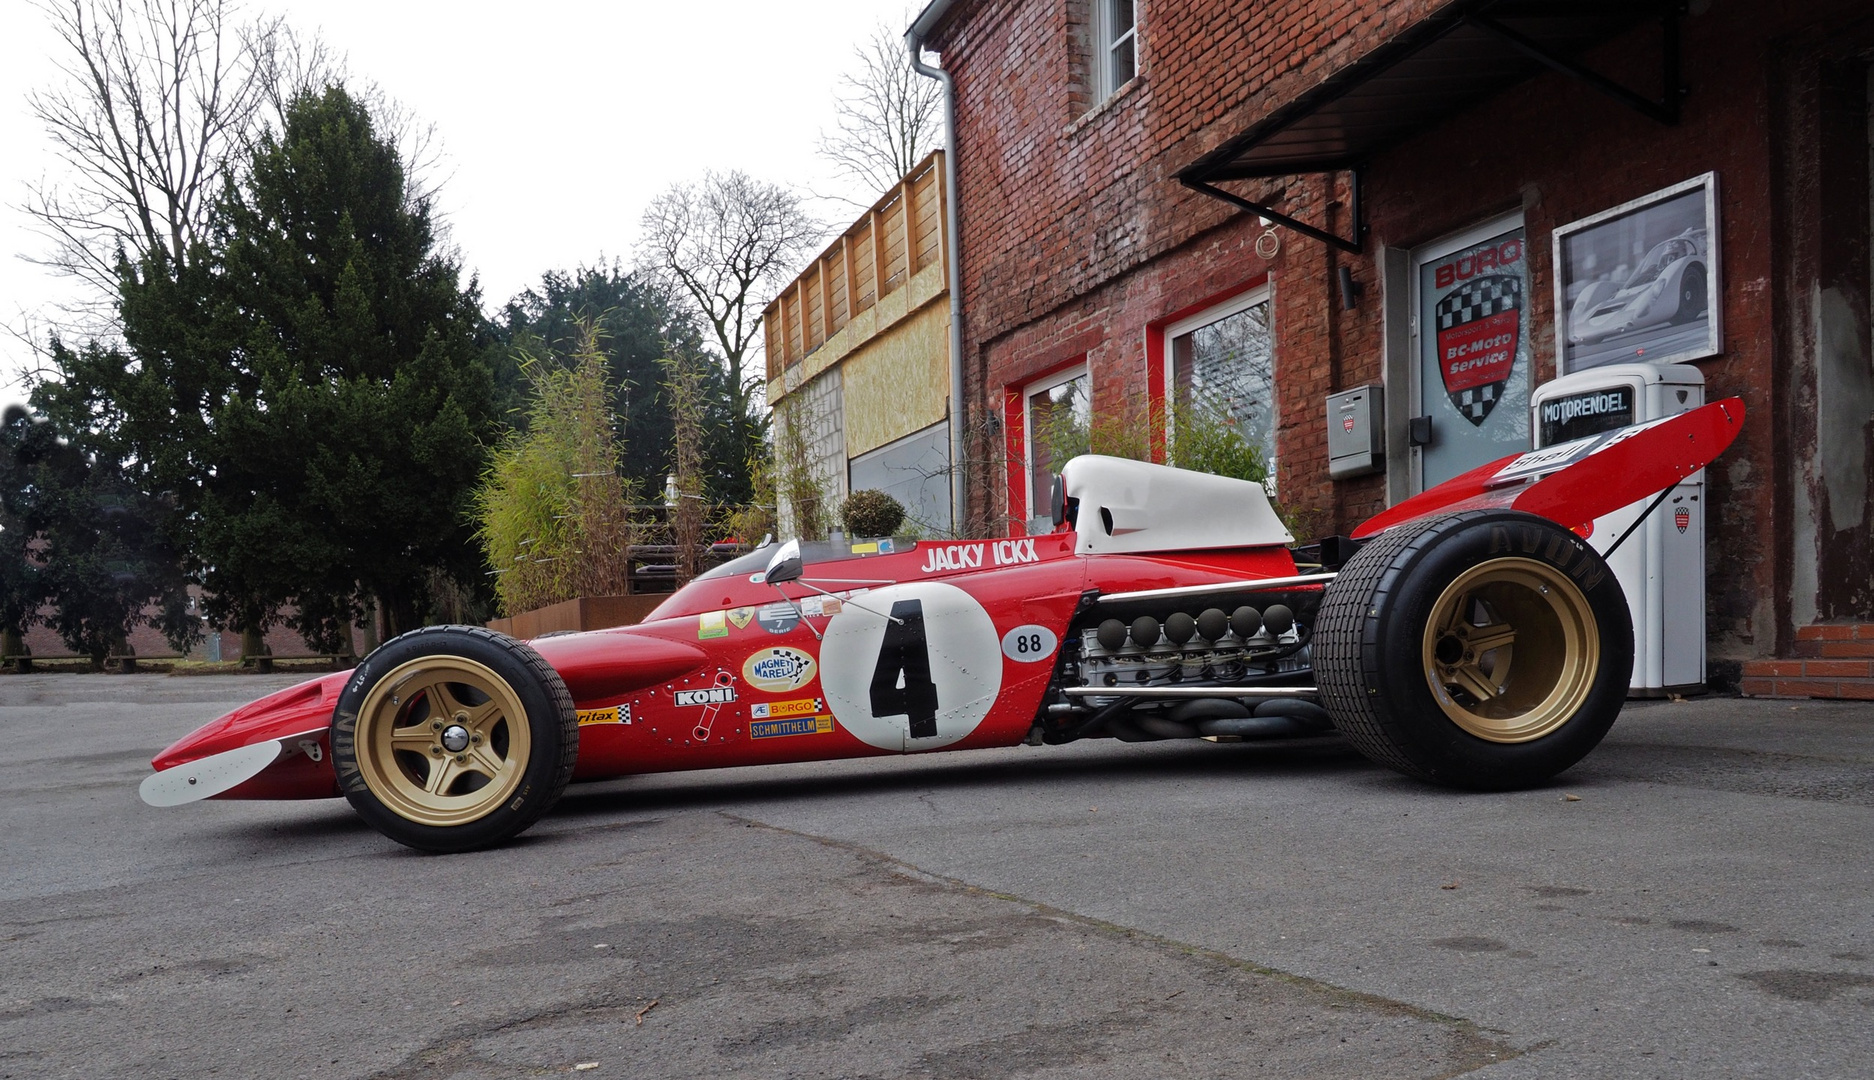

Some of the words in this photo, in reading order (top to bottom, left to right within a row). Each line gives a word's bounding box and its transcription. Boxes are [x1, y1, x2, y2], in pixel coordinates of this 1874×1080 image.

[1446, 333, 1512, 360] BC-Moto
[1450, 350, 1508, 374] Service
[921, 543, 984, 573] JACKY
[992, 538, 1039, 565] ICKX
[1489, 525, 1605, 592] AVON
[775, 619, 783, 628] 7
[1017, 634, 1042, 653] 88
[869, 599, 939, 738] 4
[677, 688, 732, 705] KONI
[577, 711, 614, 723] ritax
[771, 702, 812, 713] BORGO
[752, 720, 815, 736] SCHMITTHELM
